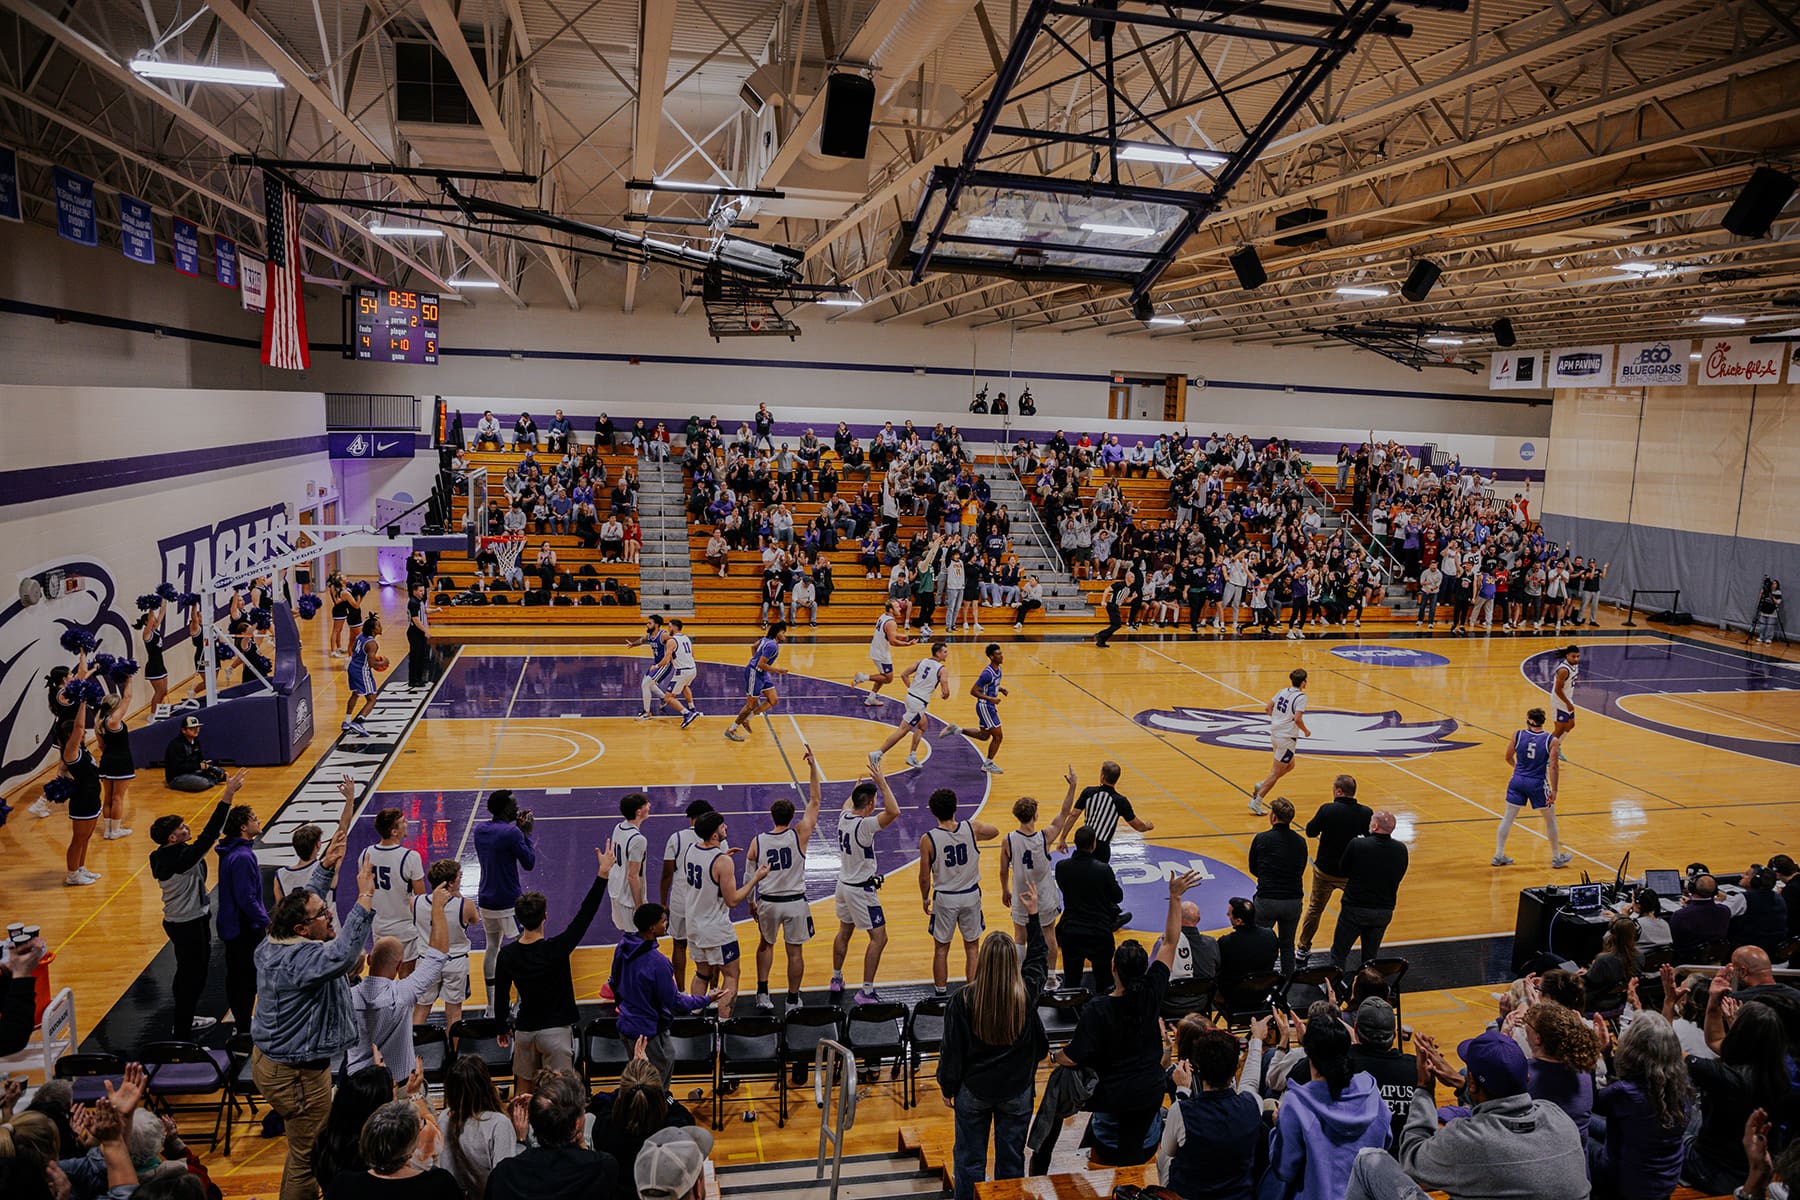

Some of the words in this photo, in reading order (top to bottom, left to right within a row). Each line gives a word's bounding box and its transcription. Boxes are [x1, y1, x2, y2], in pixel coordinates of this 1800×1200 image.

[360, 297, 378, 314] 54
[389, 290, 417, 309] 8:35
[422, 304, 438, 321] 50
[410, 315, 418, 328] 2
[362, 336, 370, 348] 4
[427, 340, 435, 353] 5
[1558, 360, 1574, 371] APM
[1574, 358, 1601, 370] PAVING
[1622, 364, 1682, 375] BLUEGRASS
[1706, 345, 1777, 380] Chick-fil-A
[291, 547, 324, 562] LEGACY
[234, 565, 271, 581] SPORTS
[921, 667, 931, 679] 5
[1277, 696, 1289, 713] 25
[1527, 742, 1536, 760] 5
[767, 847, 792, 870] 20
[944, 844, 967, 868] 30
[1022, 850, 1034, 869] 4
[686, 862, 702, 889] 33
